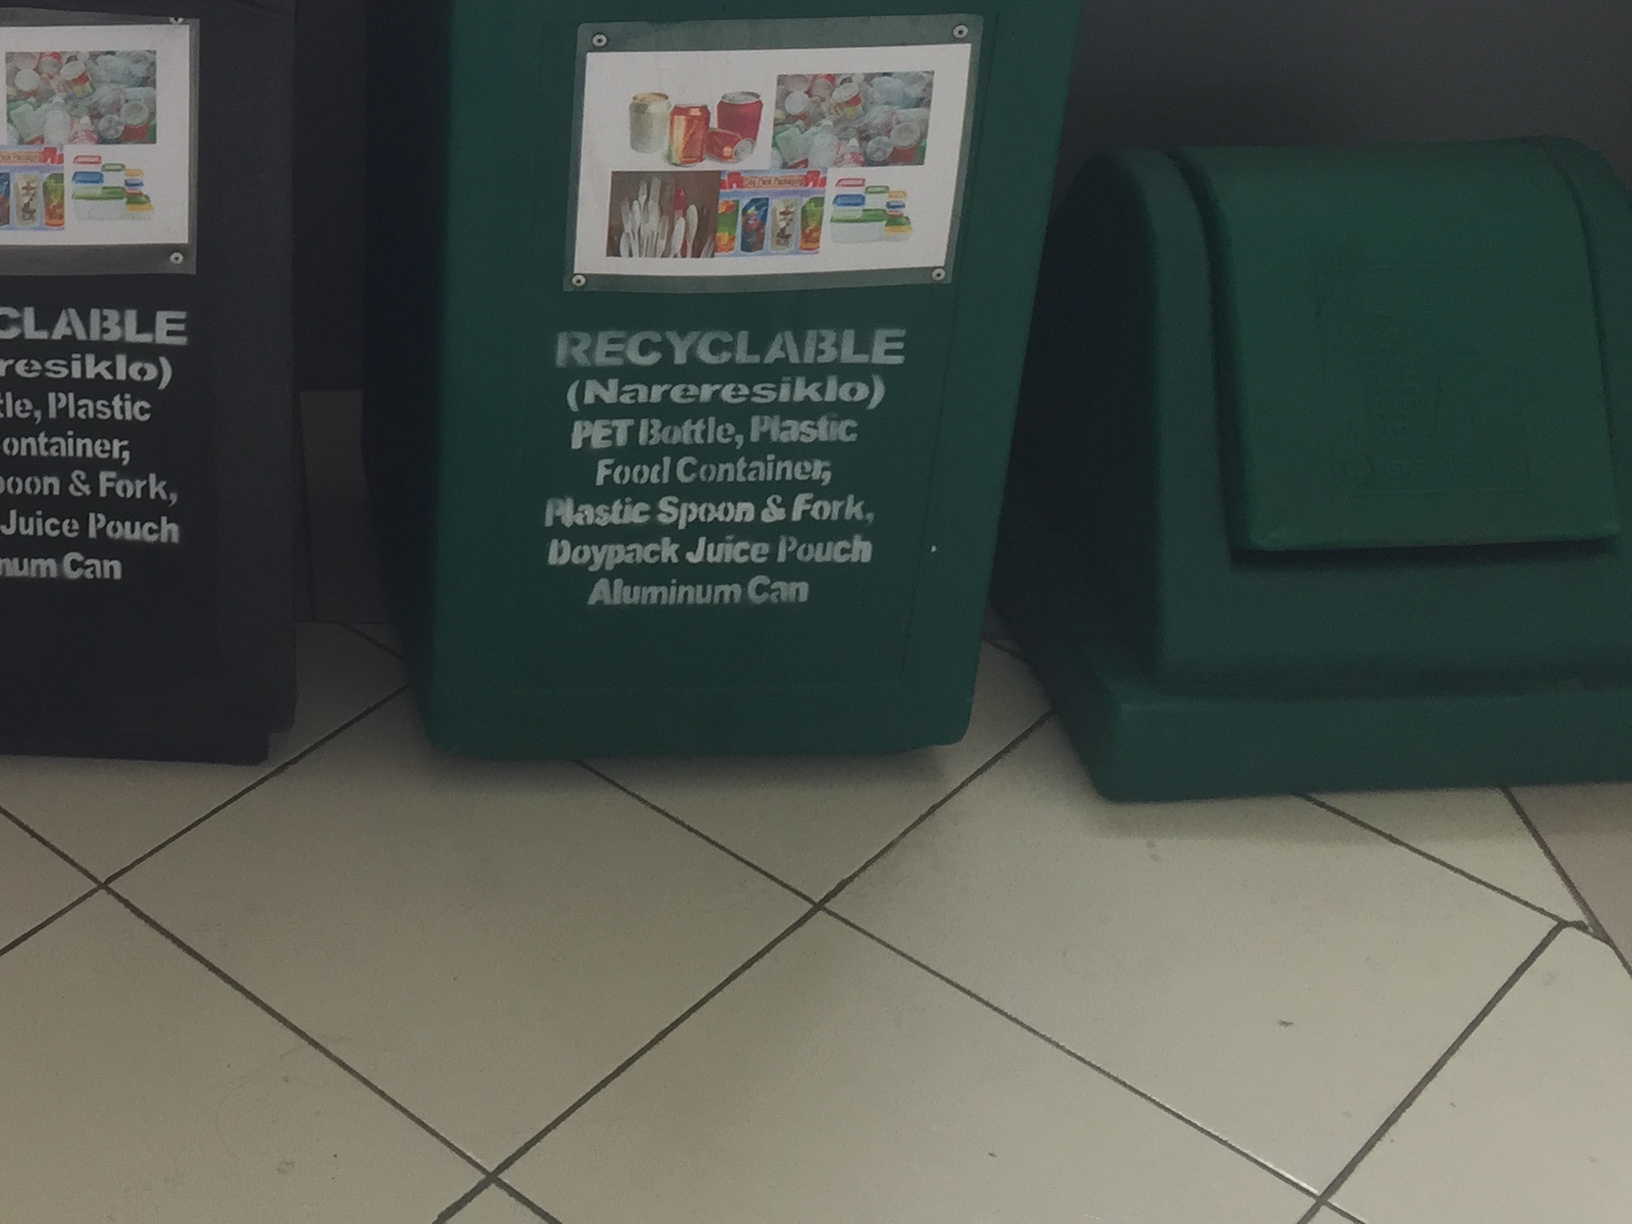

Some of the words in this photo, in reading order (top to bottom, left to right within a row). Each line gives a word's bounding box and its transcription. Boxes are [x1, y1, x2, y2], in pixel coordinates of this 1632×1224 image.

[555, 328, 907, 368] RECYCLABLE
[48, 392, 151, 421] Plastic
[566, 375, 885, 411] (Nareresiklo)
[571, 418, 634, 449] PET
[639, 416, 745, 449] Bottle,
[750, 414, 858, 443] Plastic
[595, 456, 671, 486] Food
[676, 453, 832, 486] Container,
[69, 469, 91, 497] &
[99, 471, 178, 506] Fork,
[0, 509, 79, 538] Juice
[88, 512, 180, 543] Pouch
[544, 496, 650, 528] Plastic
[657, 496, 755, 529] Spoon
[761, 494, 786, 523] &
[792, 493, 874, 525] Fork,
[63, 551, 122, 580] Can
[548, 534, 679, 571] Doypack
[685, 535, 769, 564] Juice
[777, 534, 872, 563] Pouch
[588, 578, 742, 605] Aluminum
[747, 575, 809, 604] Can
